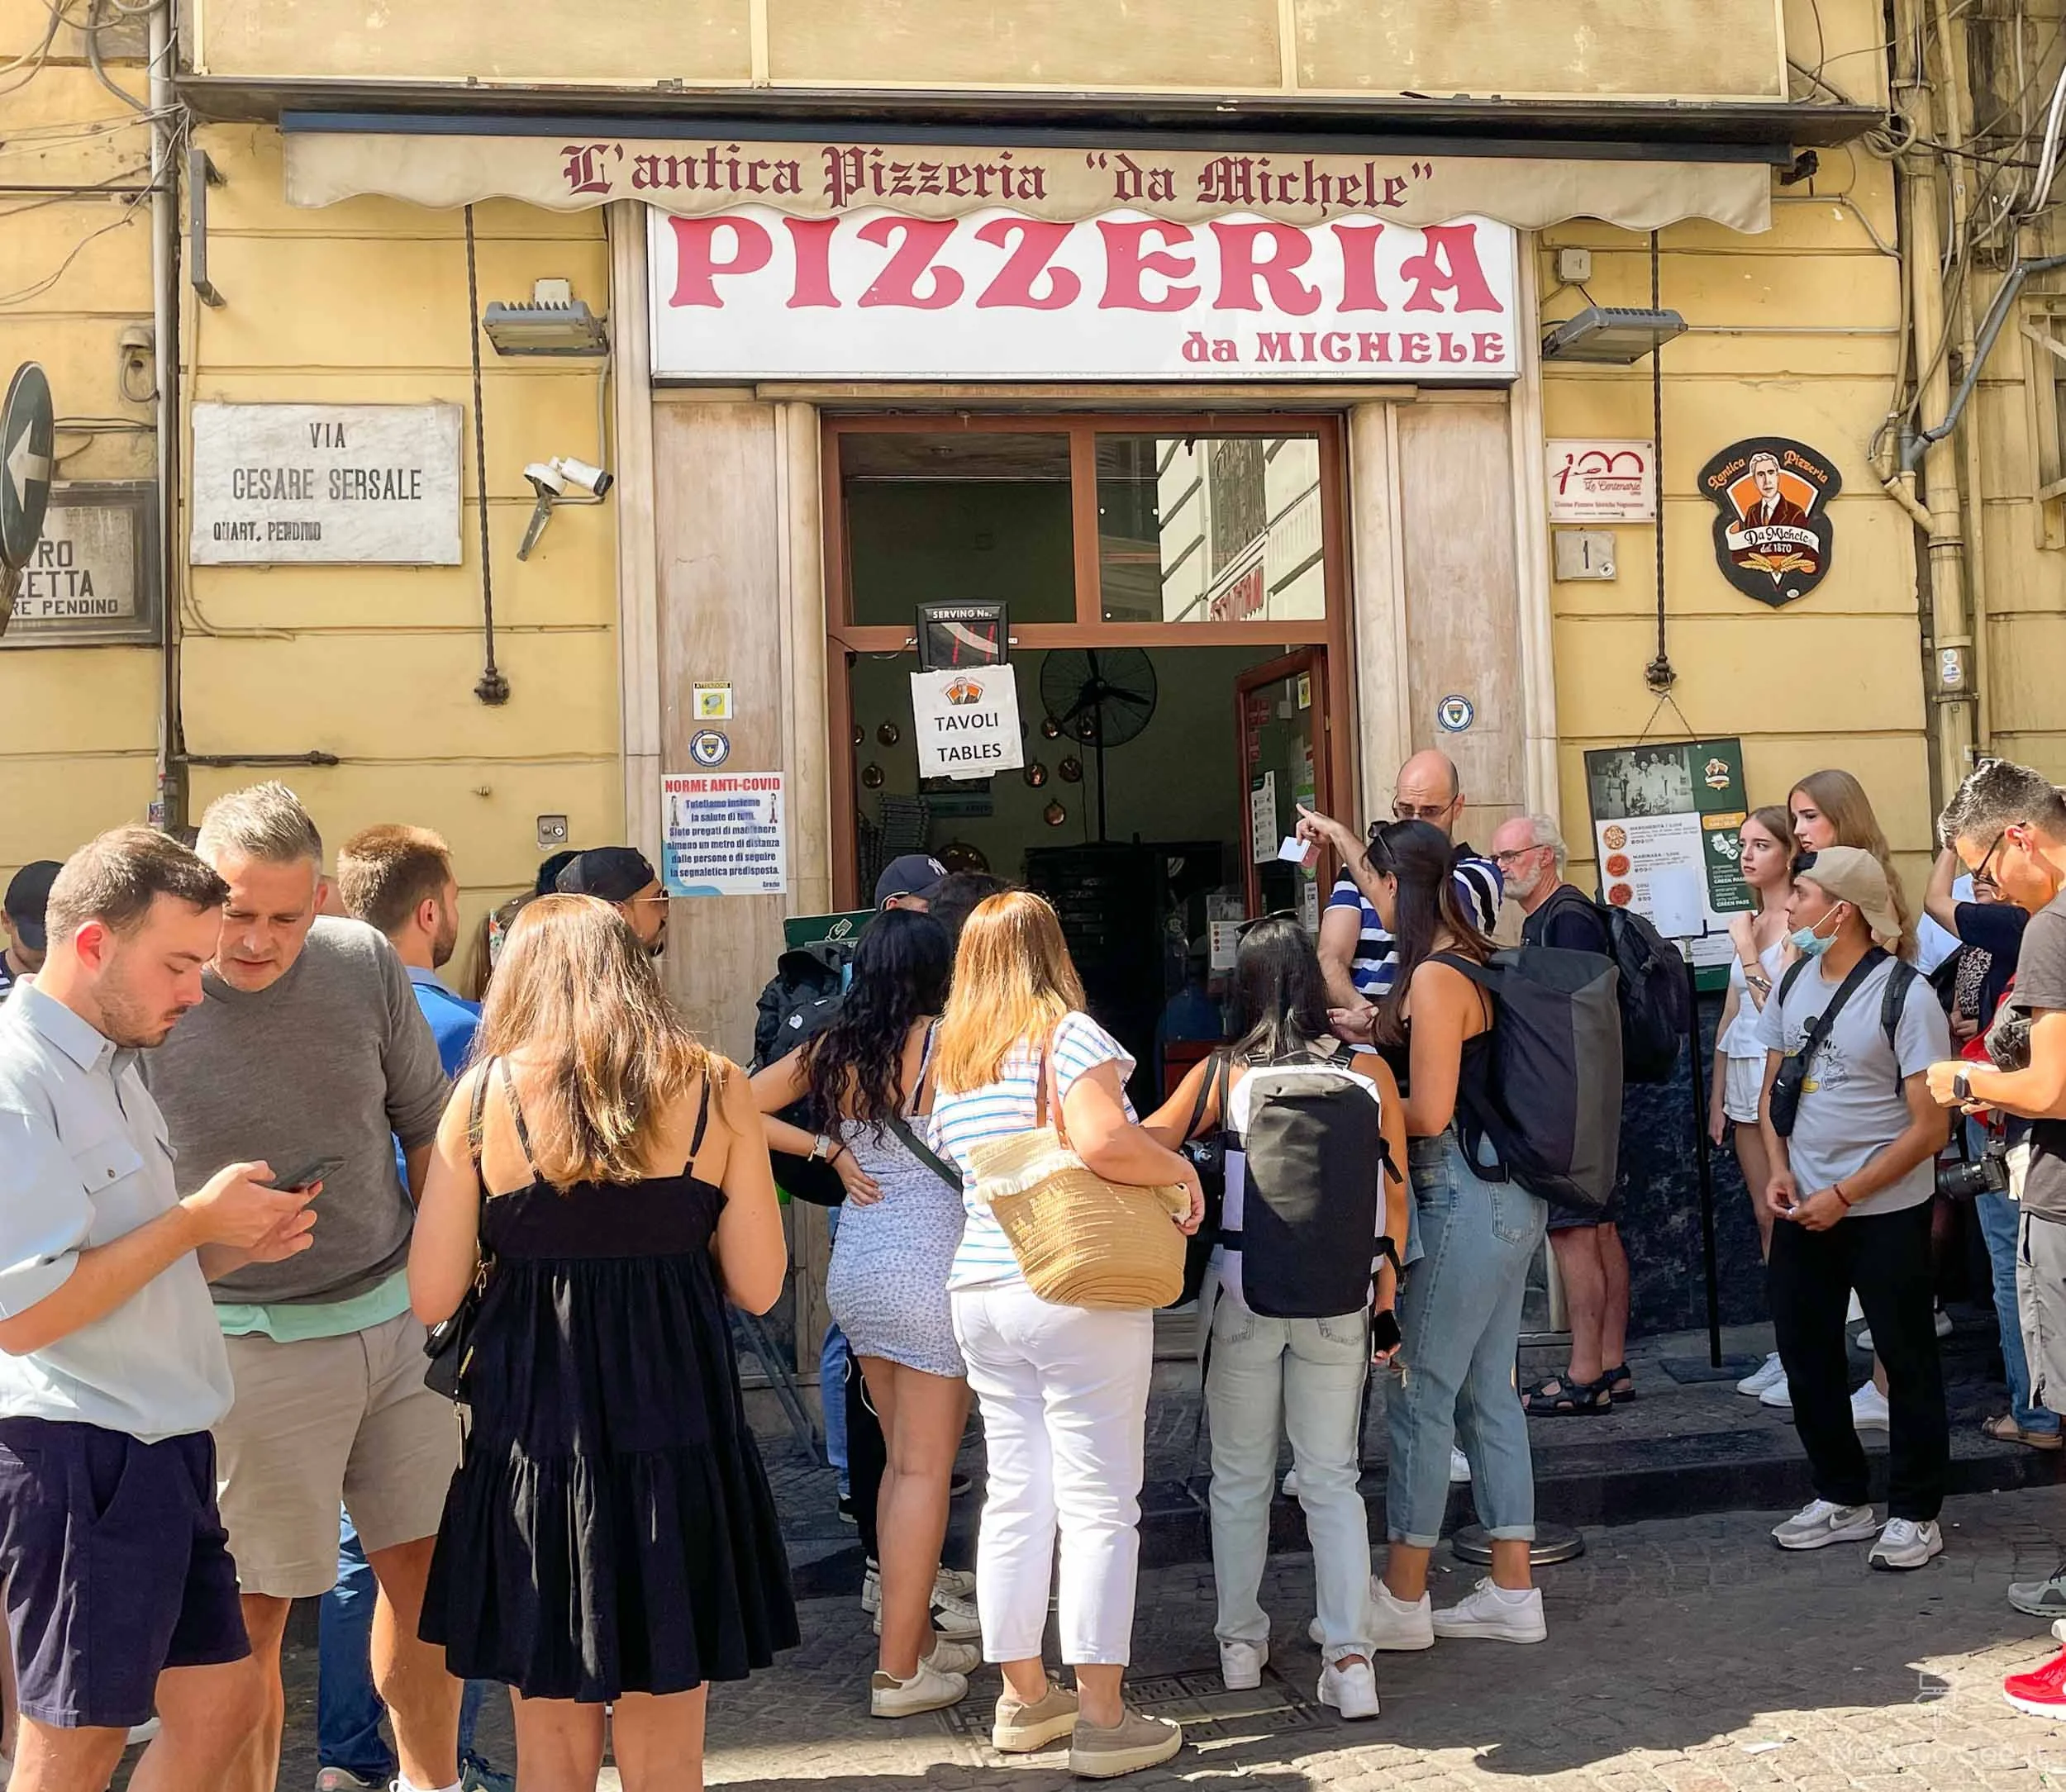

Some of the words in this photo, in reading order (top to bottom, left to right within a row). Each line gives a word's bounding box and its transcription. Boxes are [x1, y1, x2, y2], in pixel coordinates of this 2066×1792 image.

[559, 143, 803, 196] L'antica
[821, 146, 1048, 209] Pizzeria
[668, 216, 1504, 316] PIZZERIA
[1182, 331, 1240, 364] da
[1255, 332, 1506, 364] MICHELE
[309, 422, 346, 449] VIA
[1783, 450, 1829, 485] Pizzeria
[233, 468, 314, 501] CESARE
[329, 468, 422, 501] SERSALE
[213, 521, 262, 542] QUART.
[268, 521, 321, 542] PENDINO
[1744, 530, 1765, 545] Da
[1765, 526, 1809, 544] Michele
[26, 540, 73, 568] RO
[1773, 544, 1792, 554] 1870
[42, 599, 118, 616] PENDINO
[932, 610, 975, 619] SERVING
[934, 712, 999, 732] TAVOLI
[936, 743, 1002, 763] TABLES
[665, 779, 708, 793] NORME
[710, 777, 780, 792] ANTI-COVID
[701, 812, 726, 821] salute
[727, 812, 735, 820] di
[692, 827, 721, 837] pregati
[723, 826, 731, 834] di
[711, 840, 735, 848] metro
[736, 839, 745, 848] di
[746, 839, 780, 848] distanza
[693, 854, 727, 863] persone
[735, 853, 744, 862] di
[680, 867, 728, 878] segnaletica
[729, 866, 780, 877] predisposta.
